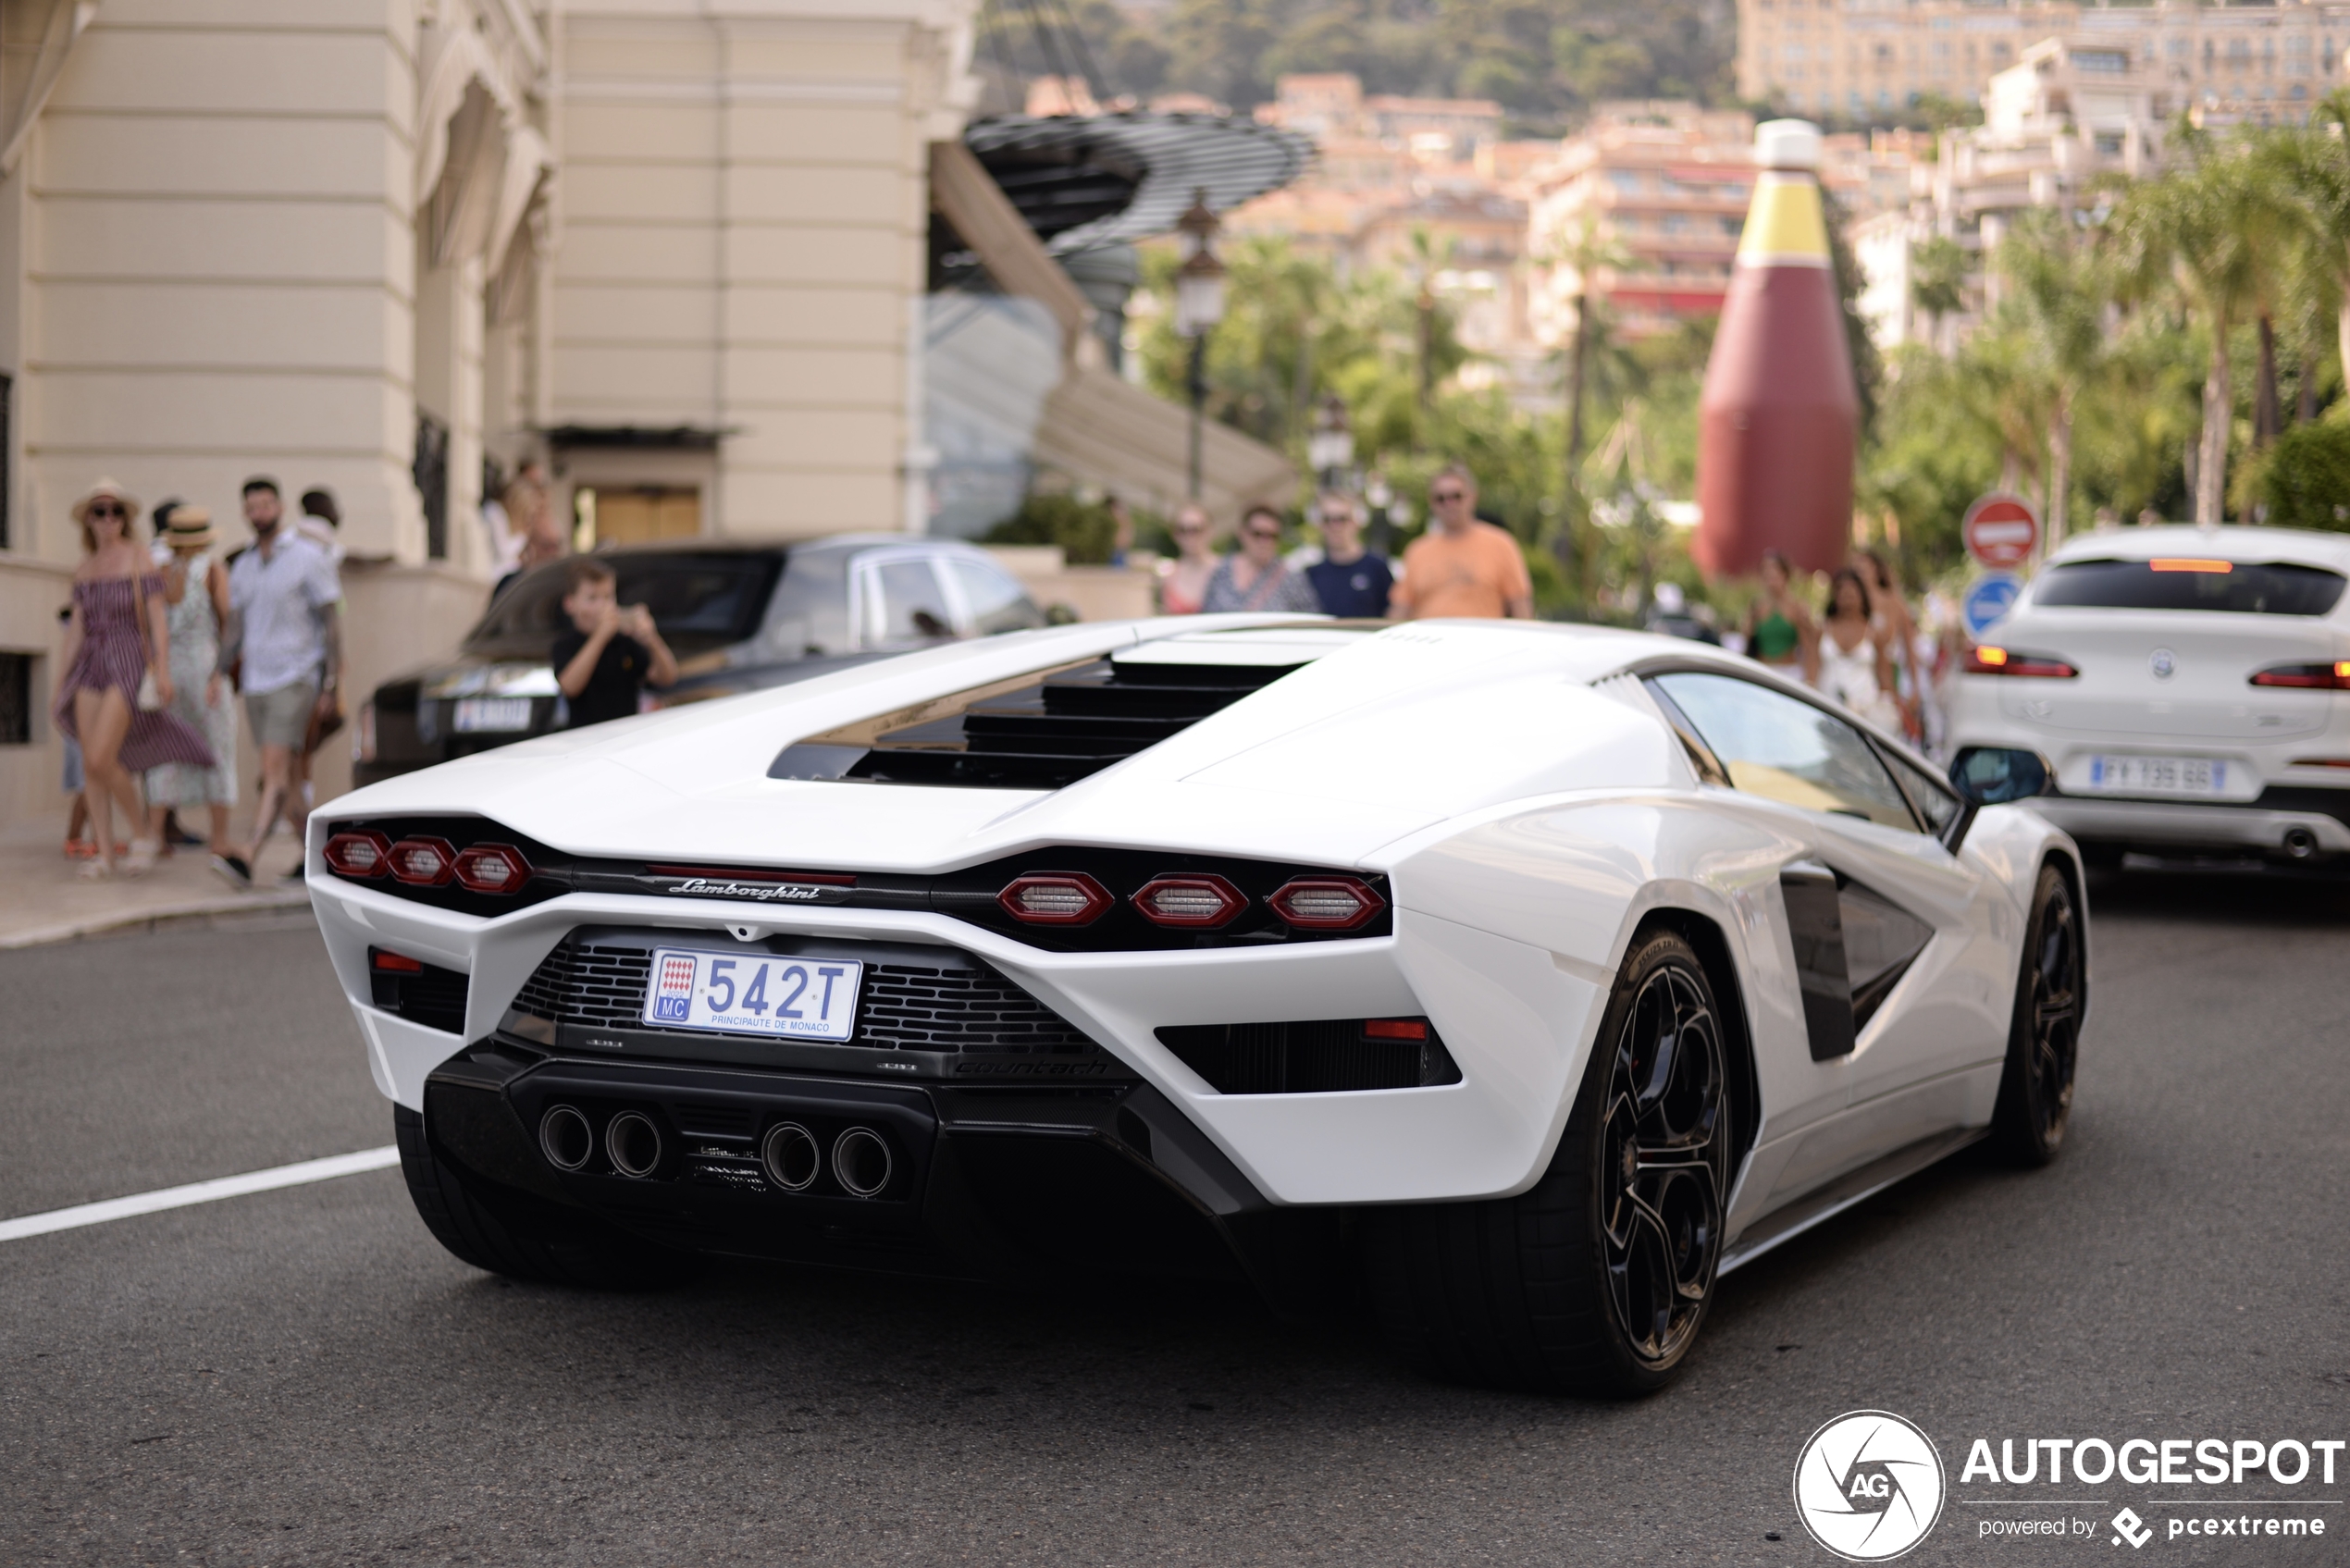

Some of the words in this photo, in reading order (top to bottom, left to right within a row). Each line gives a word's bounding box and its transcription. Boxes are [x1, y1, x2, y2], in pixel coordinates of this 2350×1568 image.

[668, 878, 820, 900] Lamborghini
[666, 990, 685, 998] 2022
[707, 959, 845, 1021] 542T
[662, 999, 685, 1017] MC
[711, 1015, 772, 1030] PRINCIPAUTE
[774, 1019, 786, 1030] DE
[789, 1020, 830, 1033] MONACO
[956, 1059, 1108, 1075] countach
